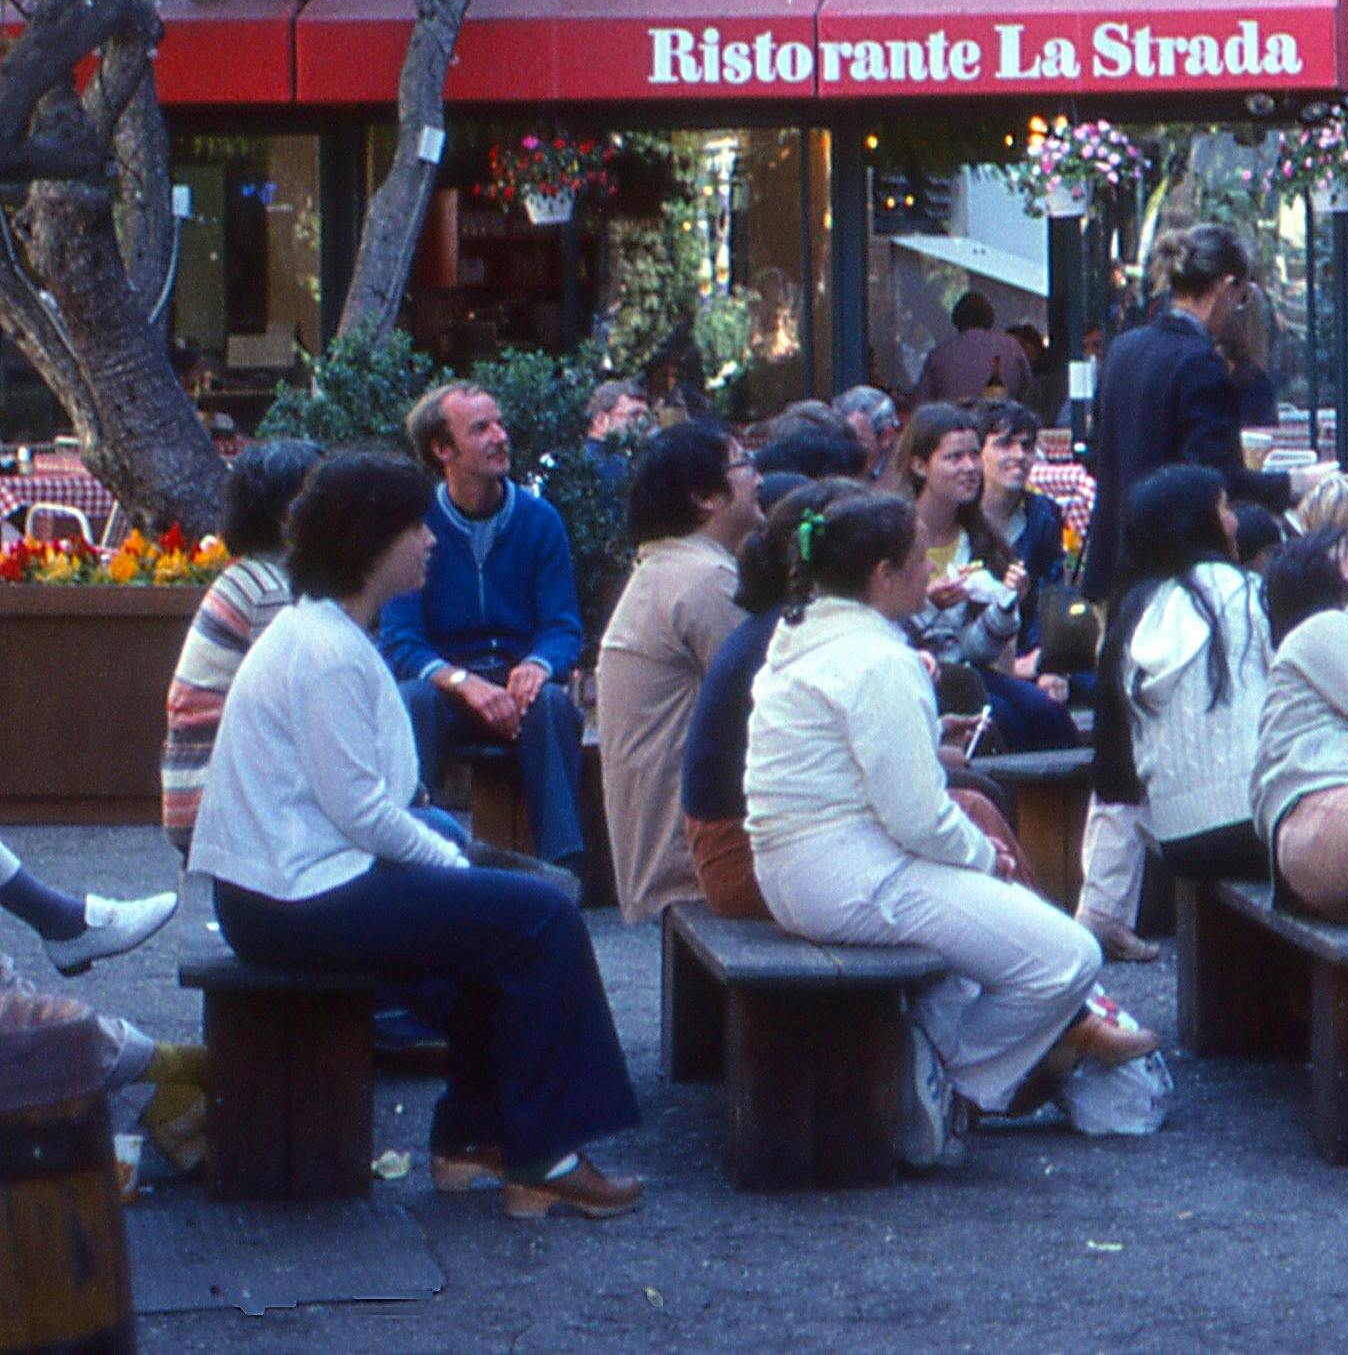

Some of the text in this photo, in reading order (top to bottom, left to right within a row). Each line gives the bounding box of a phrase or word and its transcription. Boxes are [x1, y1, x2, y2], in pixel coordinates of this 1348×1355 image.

[648, 19, 1303, 84] Ristorante La Strada
